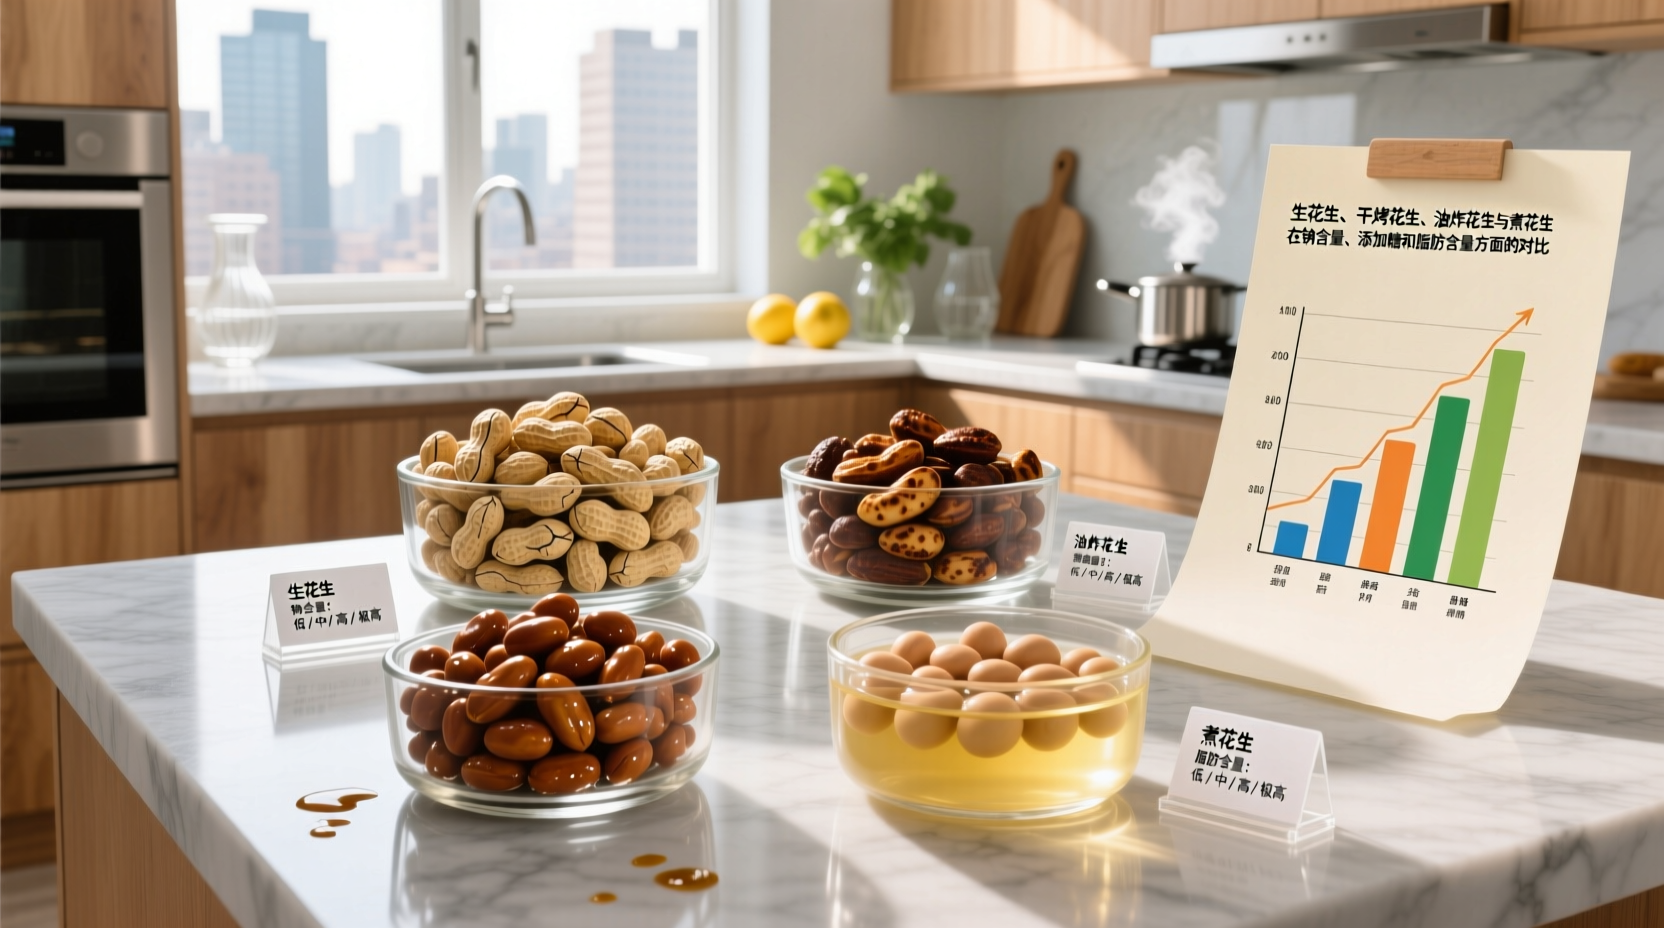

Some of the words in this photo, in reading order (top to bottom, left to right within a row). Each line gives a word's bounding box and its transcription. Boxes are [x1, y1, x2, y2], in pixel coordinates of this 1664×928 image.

[288, 580, 335, 599] 生花生
[1200, 725, 1253, 753] 煮花生
